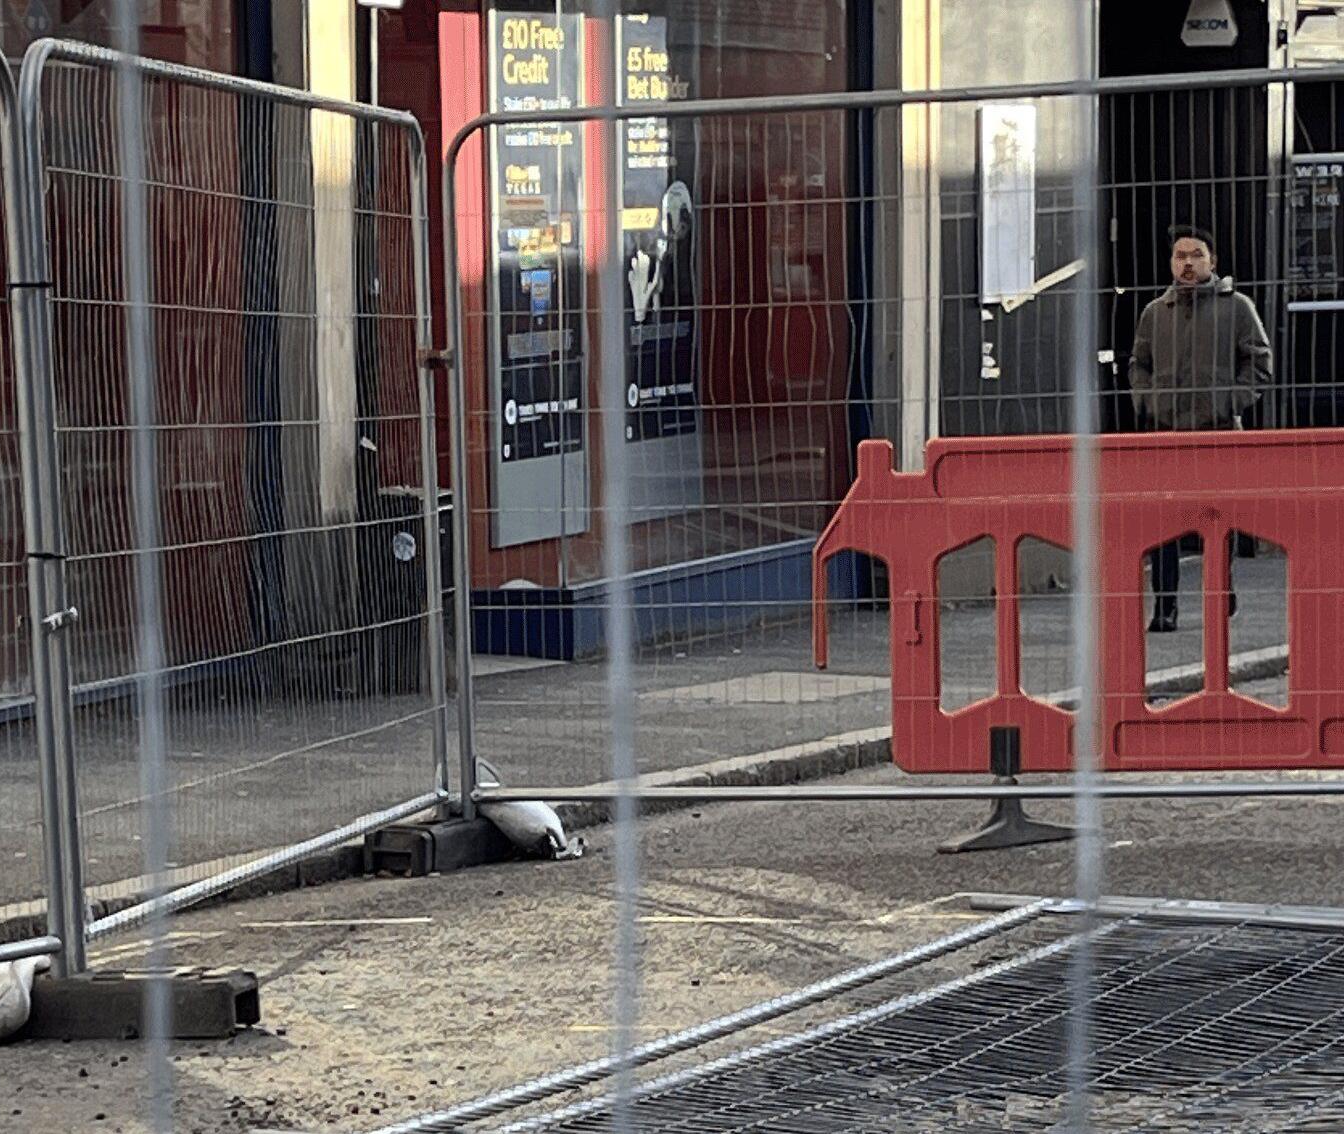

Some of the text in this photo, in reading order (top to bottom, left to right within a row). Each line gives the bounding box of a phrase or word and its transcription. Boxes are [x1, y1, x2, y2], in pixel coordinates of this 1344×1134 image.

[502, 19, 565, 49] £10 Free
[502, 53, 549, 85] Credit
[643, 46, 668, 72] free
[627, 74, 689, 100] Bet Builder
